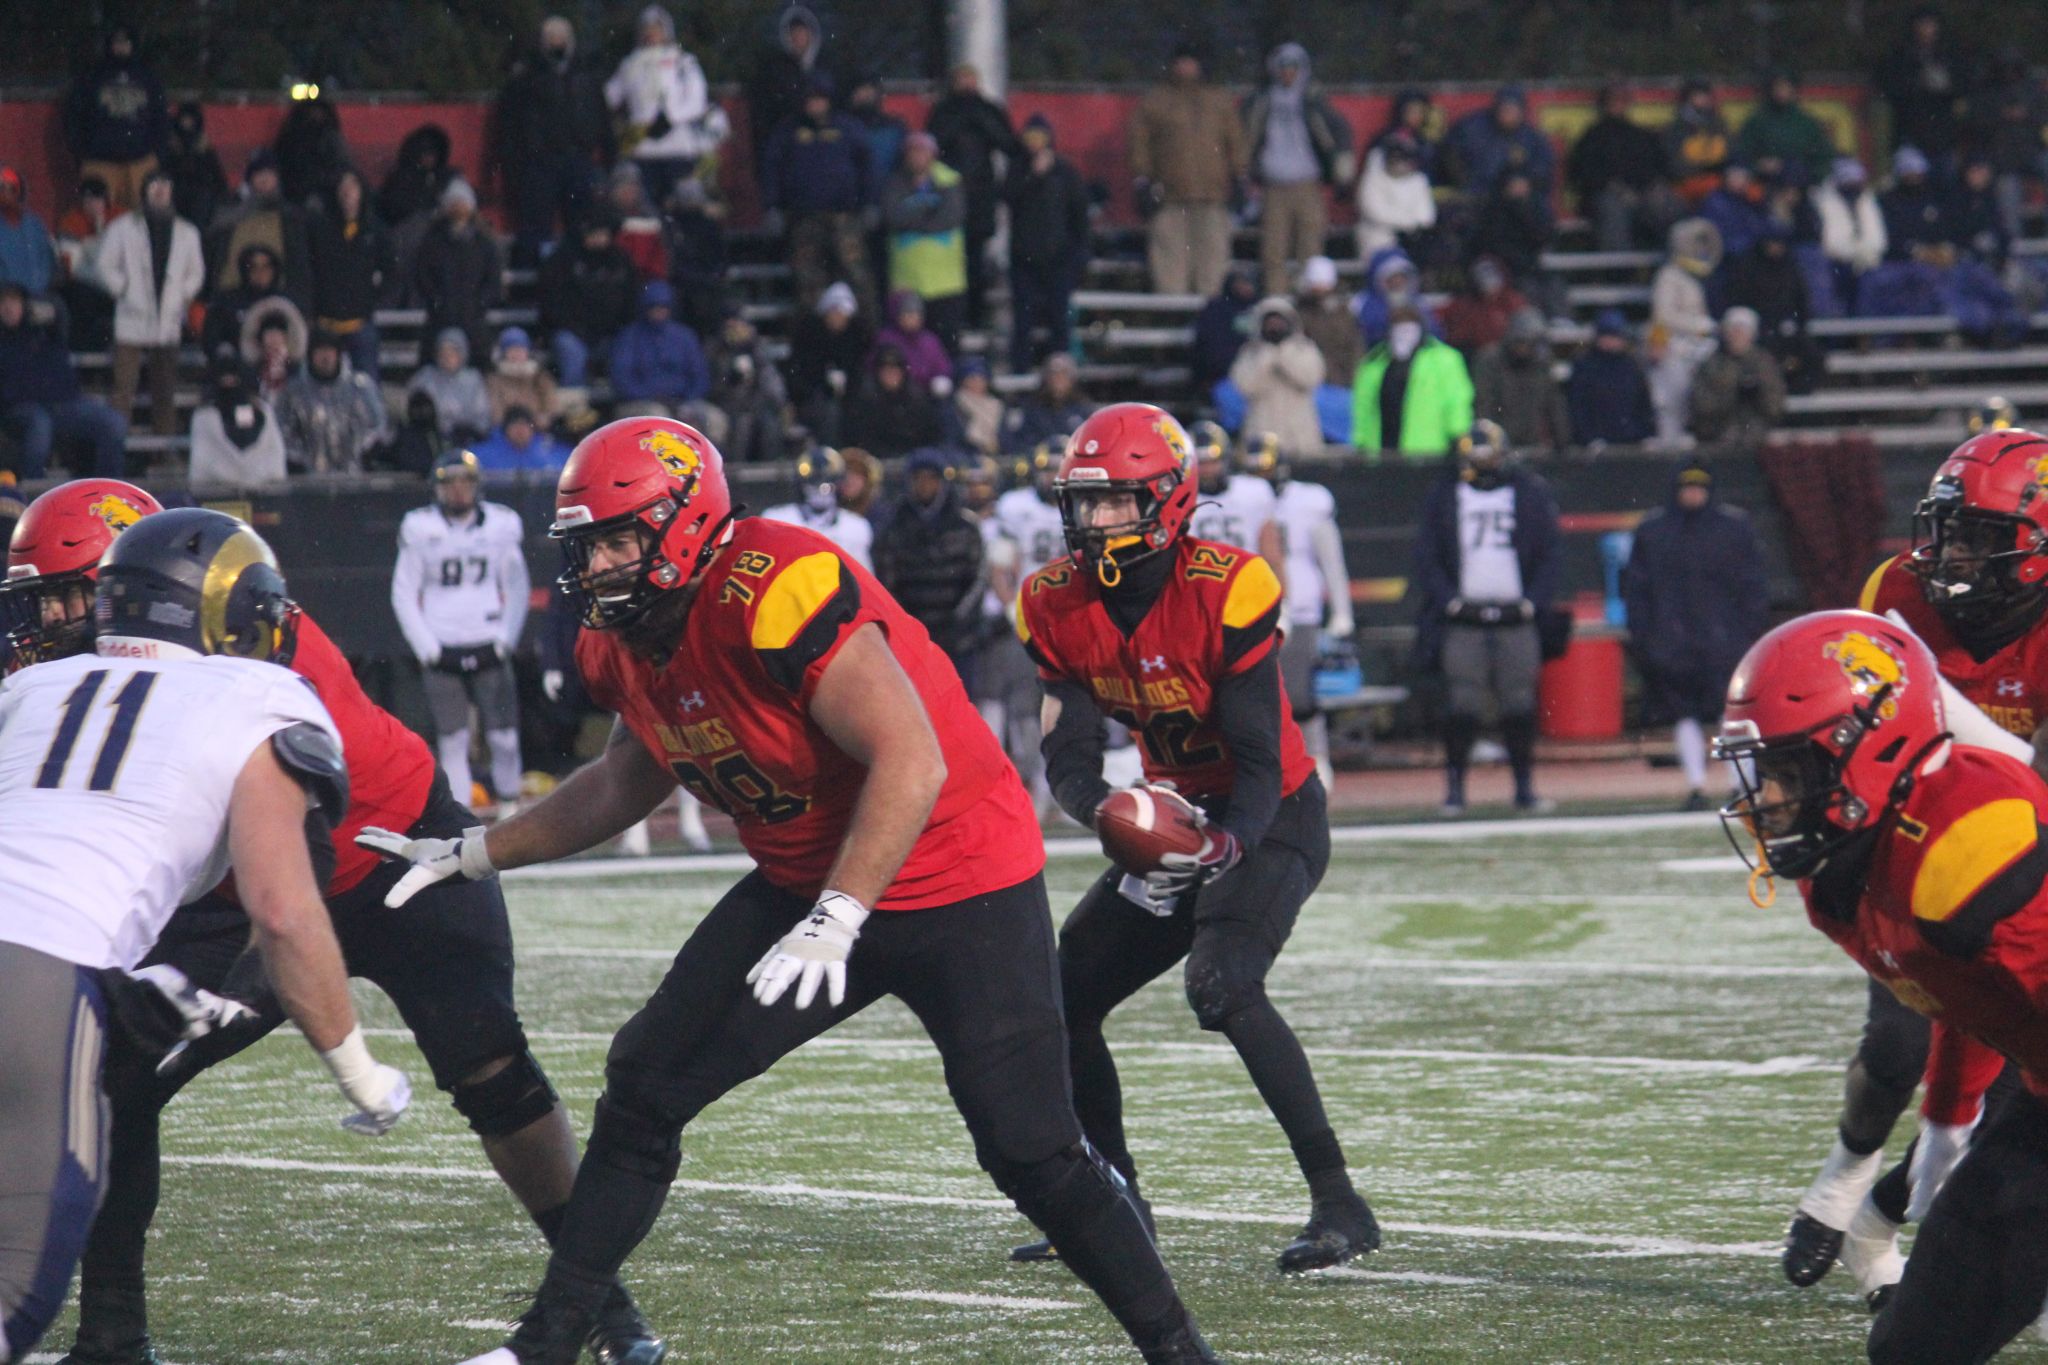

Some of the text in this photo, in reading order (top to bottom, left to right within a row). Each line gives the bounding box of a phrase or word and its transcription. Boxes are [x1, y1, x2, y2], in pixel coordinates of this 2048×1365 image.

[1467, 509, 1516, 550] 75
[719, 550, 775, 606] 78
[1185, 546, 1239, 581] 12
[33, 668, 163, 794] 11
[1110, 704, 1225, 768] 12
